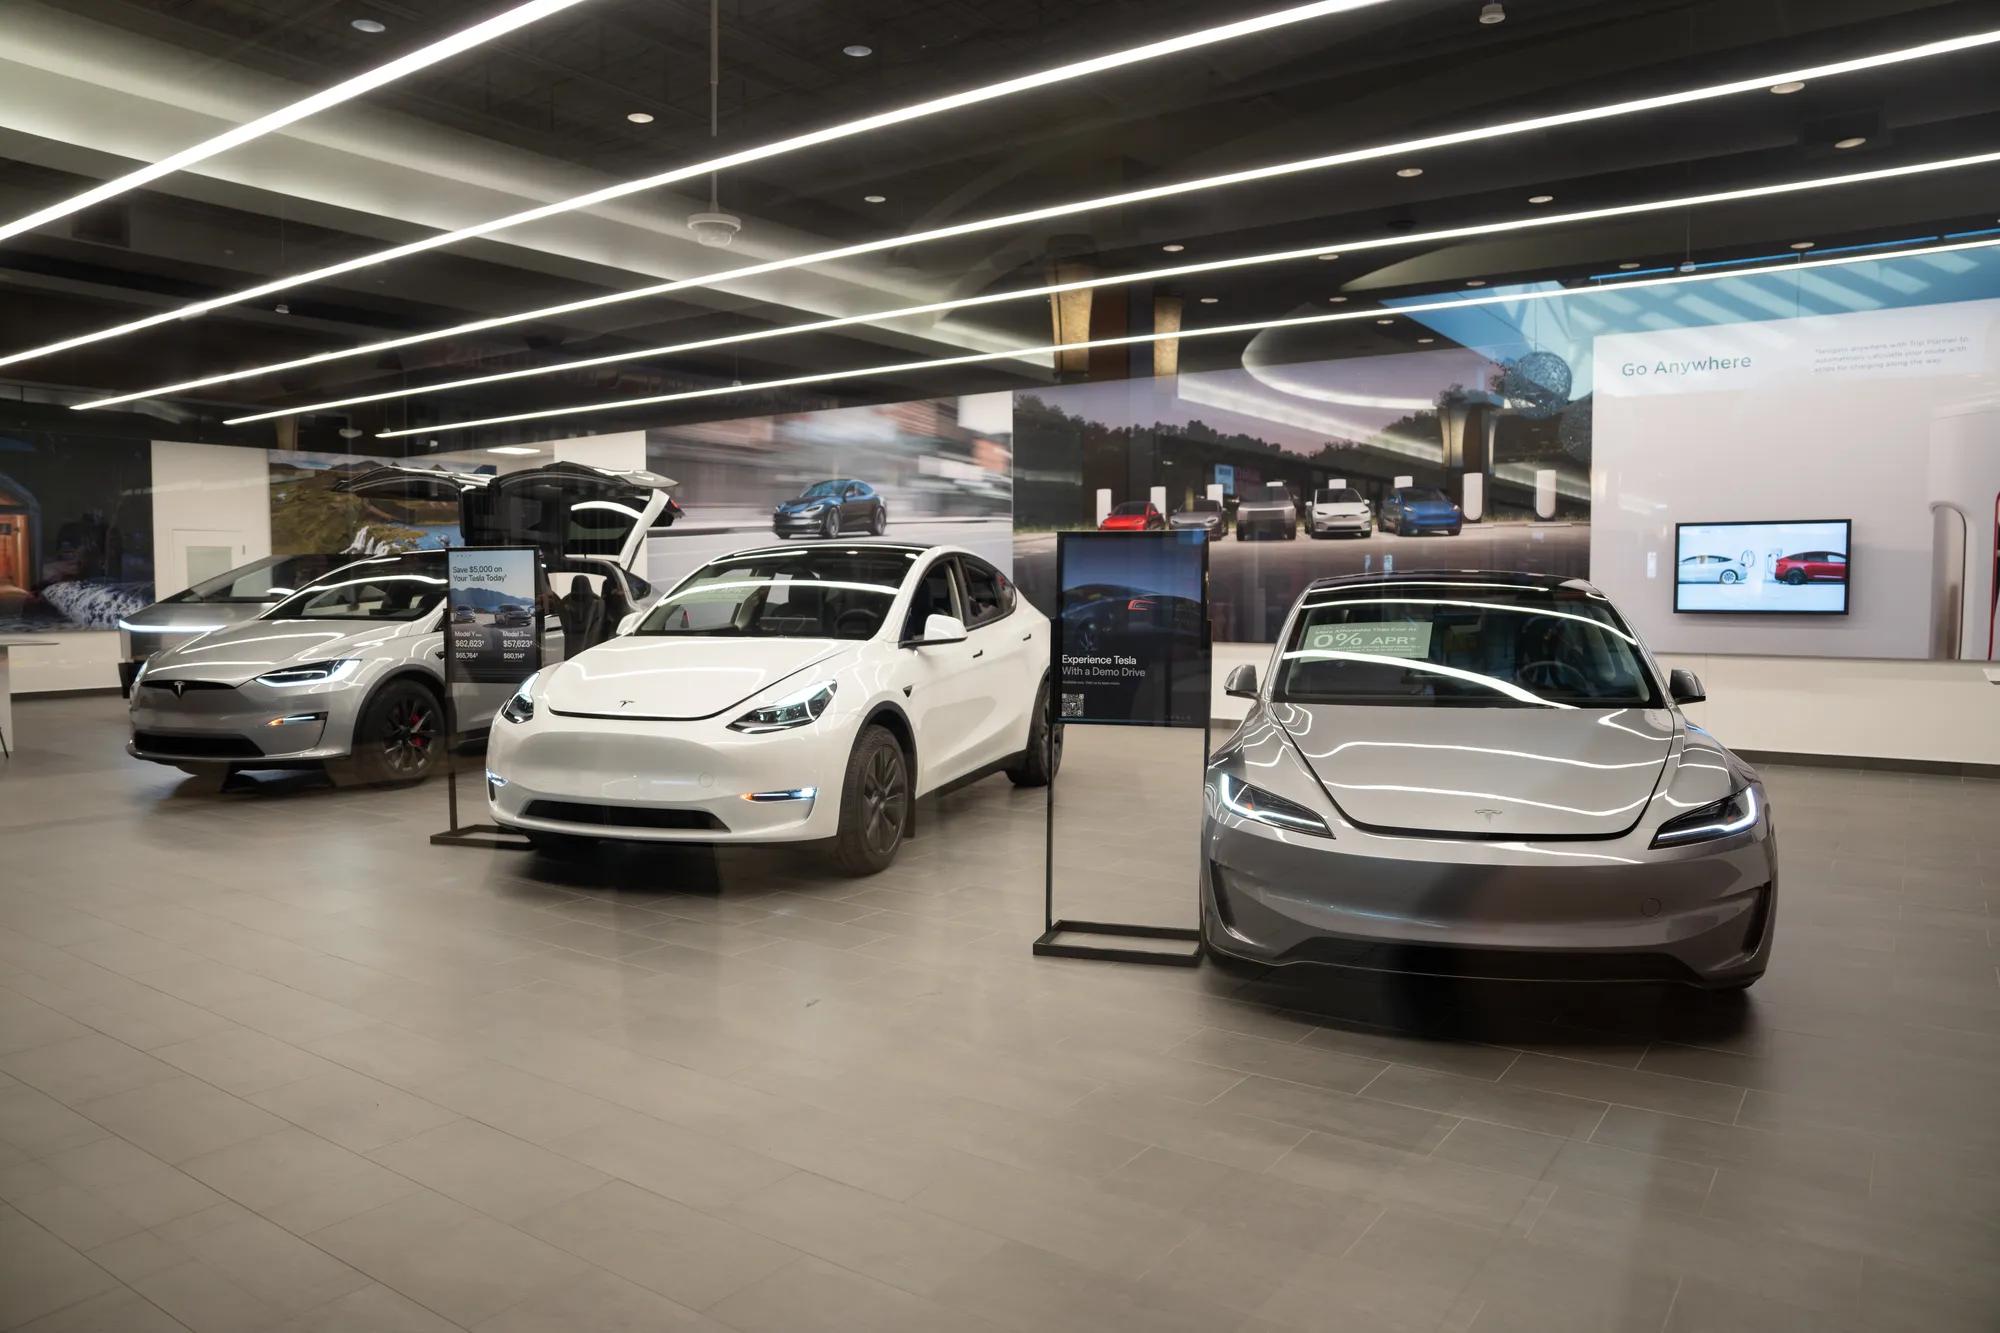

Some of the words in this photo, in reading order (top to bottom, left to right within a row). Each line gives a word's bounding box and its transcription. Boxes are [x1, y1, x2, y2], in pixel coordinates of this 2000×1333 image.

[1621, 362, 1648, 377] Go
[1654, 355, 1753, 376] Anywhere
[453, 566, 469, 574] Save
[469, 565, 493, 574] $5,000
[468, 574, 485, 582] Tesla
[1313, 632, 1363, 648] 0%
[1061, 654, 1112, 666] Experience
[1113, 655, 1137, 665] Tesla
[1061, 666, 1084, 676] With
[1084, 668, 1091, 676] a
[1092, 666, 1120, 677] Demo
[1121, 667, 1146, 677] Drive
